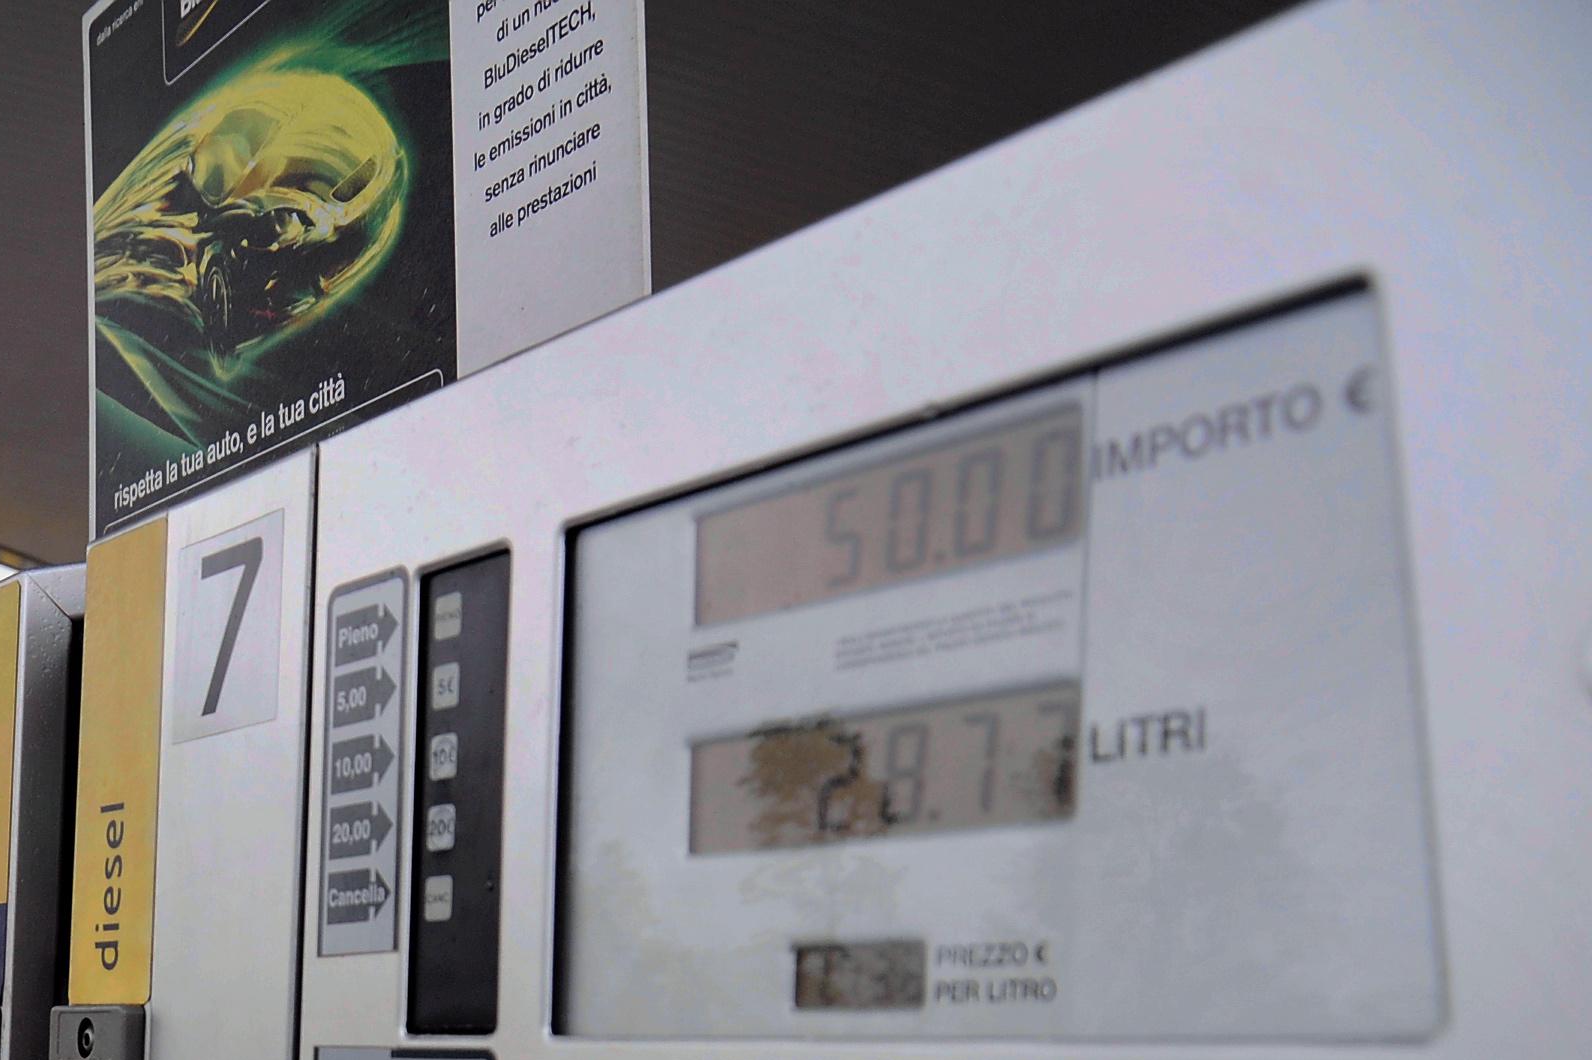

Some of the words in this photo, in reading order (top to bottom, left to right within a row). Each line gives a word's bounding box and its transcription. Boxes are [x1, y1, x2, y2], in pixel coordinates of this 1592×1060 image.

[483, 1, 596, 90] BluDieselTECH,
[496, 18, 509, 42] di
[512, 8, 530, 31] un
[474, 153, 486, 171] le
[489, 105, 556, 161] emissioni
[559, 99, 573, 119] in
[576, 73, 612, 108] città,
[478, 112, 491, 131] in
[494, 84, 534, 124] grado
[537, 68, 551, 93] di
[554, 39, 604, 82] ridurre
[484, 167, 525, 203] senza
[528, 123, 601, 178] rinunciare
[489, 212, 514, 238] alle
[517, 160, 597, 227] prestazioni
[114, 470, 162, 512] rispetta
[165, 460, 178, 485] la
[181, 449, 204, 477] tua
[207, 431, 244, 464] auto,
[246, 424, 257, 444] e
[261, 411, 275, 438] la
[279, 399, 305, 423] tua
[309, 373, 345, 414] città
[1089, 382, 1323, 482] IMPORTO
[824, 428, 1082, 588] 50.00
[201, 537, 263, 716] 7
[338, 623, 378, 648] Pieno
[336, 686, 367, 713] 5,00
[1090, 709, 1208, 765] LITRI
[335, 752, 372, 779] 10,00
[332, 819, 371, 845] 20,00
[95, 801, 125, 971] diesel
[329, 882, 386, 907] Cancella
[935, 979, 981, 1002] PER
[988, 977, 1058, 1003] LITRO
[936, 942, 1029, 969] PREZZO
